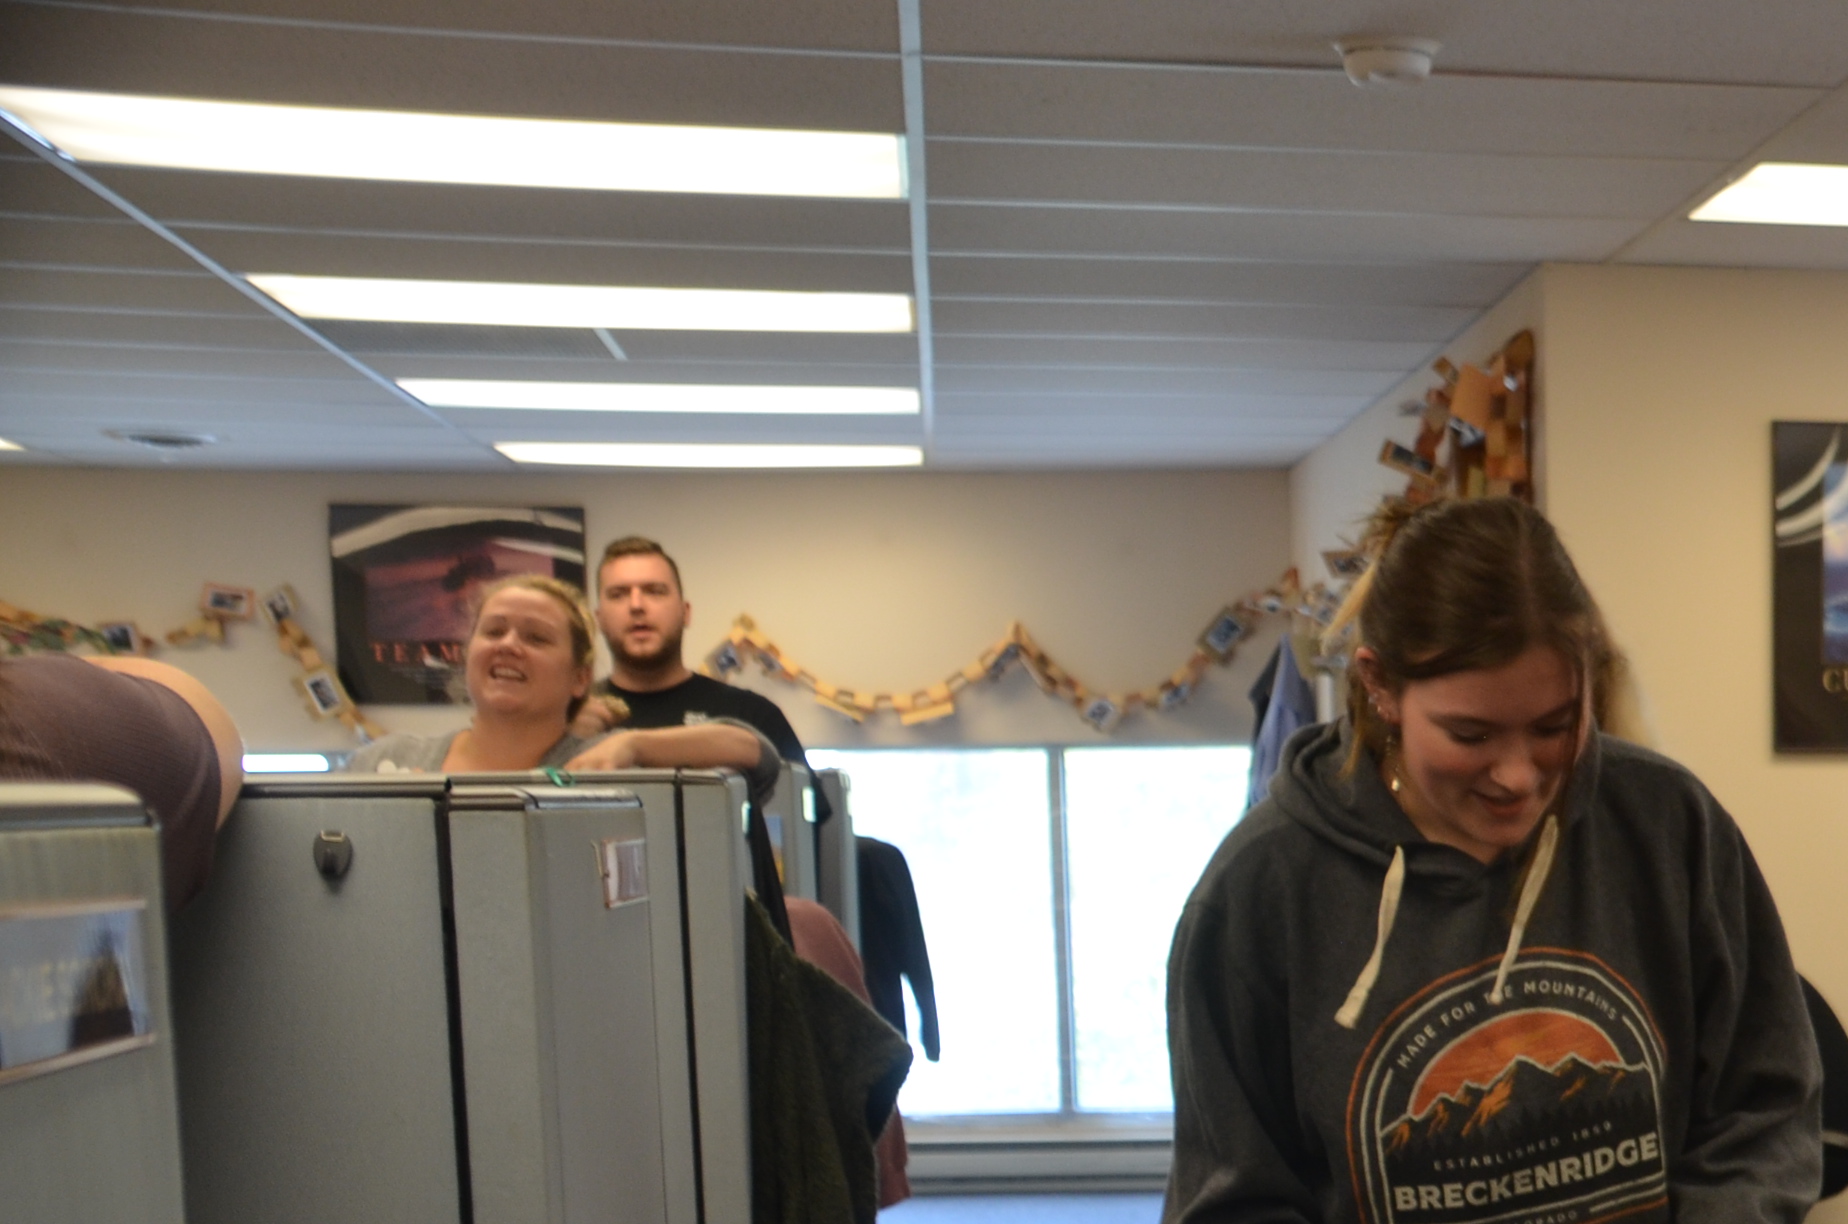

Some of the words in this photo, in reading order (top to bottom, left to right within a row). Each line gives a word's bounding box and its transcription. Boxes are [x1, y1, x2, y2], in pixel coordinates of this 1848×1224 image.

[1396, 1023, 1437, 1068] MADE
[1440, 1002, 1476, 1027] FOR
[1484, 984, 1513, 1004] TE
[1523, 979, 1617, 1021] MOUNTAINS
[1393, 1132, 1659, 1211] BRECKENRIDGE
[1433, 1136, 1560, 1172] ESTABLISHED
